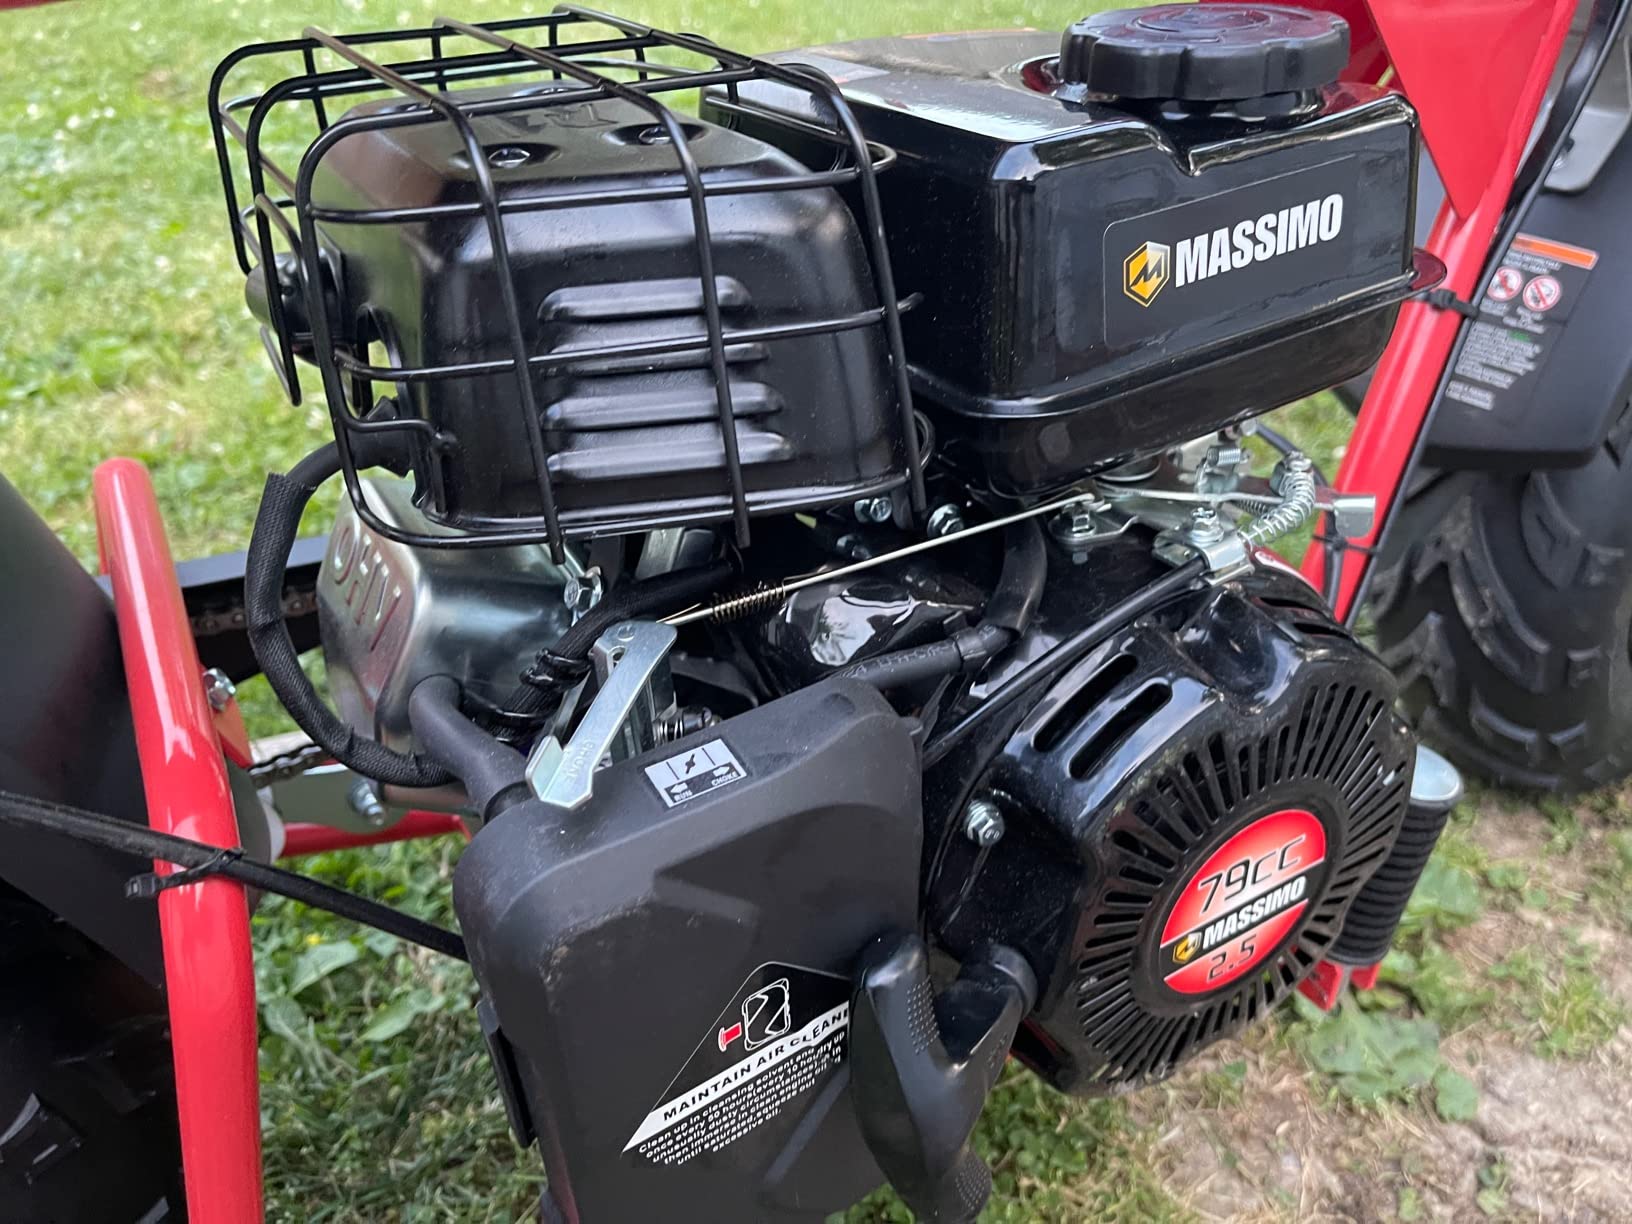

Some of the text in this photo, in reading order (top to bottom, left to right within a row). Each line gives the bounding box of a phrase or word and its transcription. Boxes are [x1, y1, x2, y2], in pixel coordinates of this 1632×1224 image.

[1175, 193, 1344, 288] MASSIMO
[673, 789, 693, 802] RUN
[711, 771, 738, 787] CHOKE
[1202, 876, 1307, 950] MASSIMO
[1208, 934, 1258, 981] 2.5
[638, 1132, 670, 1153] Clean
[673, 1122, 688, 1133] up
[690, 1114, 700, 1123] in
[702, 1083, 754, 1116] cleansing
[756, 1059, 794, 1084] solvent
[833, 1031, 845, 1045] up
[646, 1140, 673, 1157] once
[674, 1121, 704, 1140] every
[786, 1064, 798, 1073] 10
[663, 1063, 751, 1122] MAINTAIN
[756, 1044, 785, 1068] AIR
[664, 1147, 688, 1164] then
[690, 1118, 736, 1147] immerse
[738, 1111, 748, 1120] in
[750, 1094, 774, 1112] clean
[778, 1073, 812, 1094] engine
[652, 1129, 706, 1161] unusually
[708, 1110, 738, 1129] dusty
[676, 1146, 702, 1164] until
[798, 1079, 814, 1091] out
[712, 1118, 764, 1151] excessive
